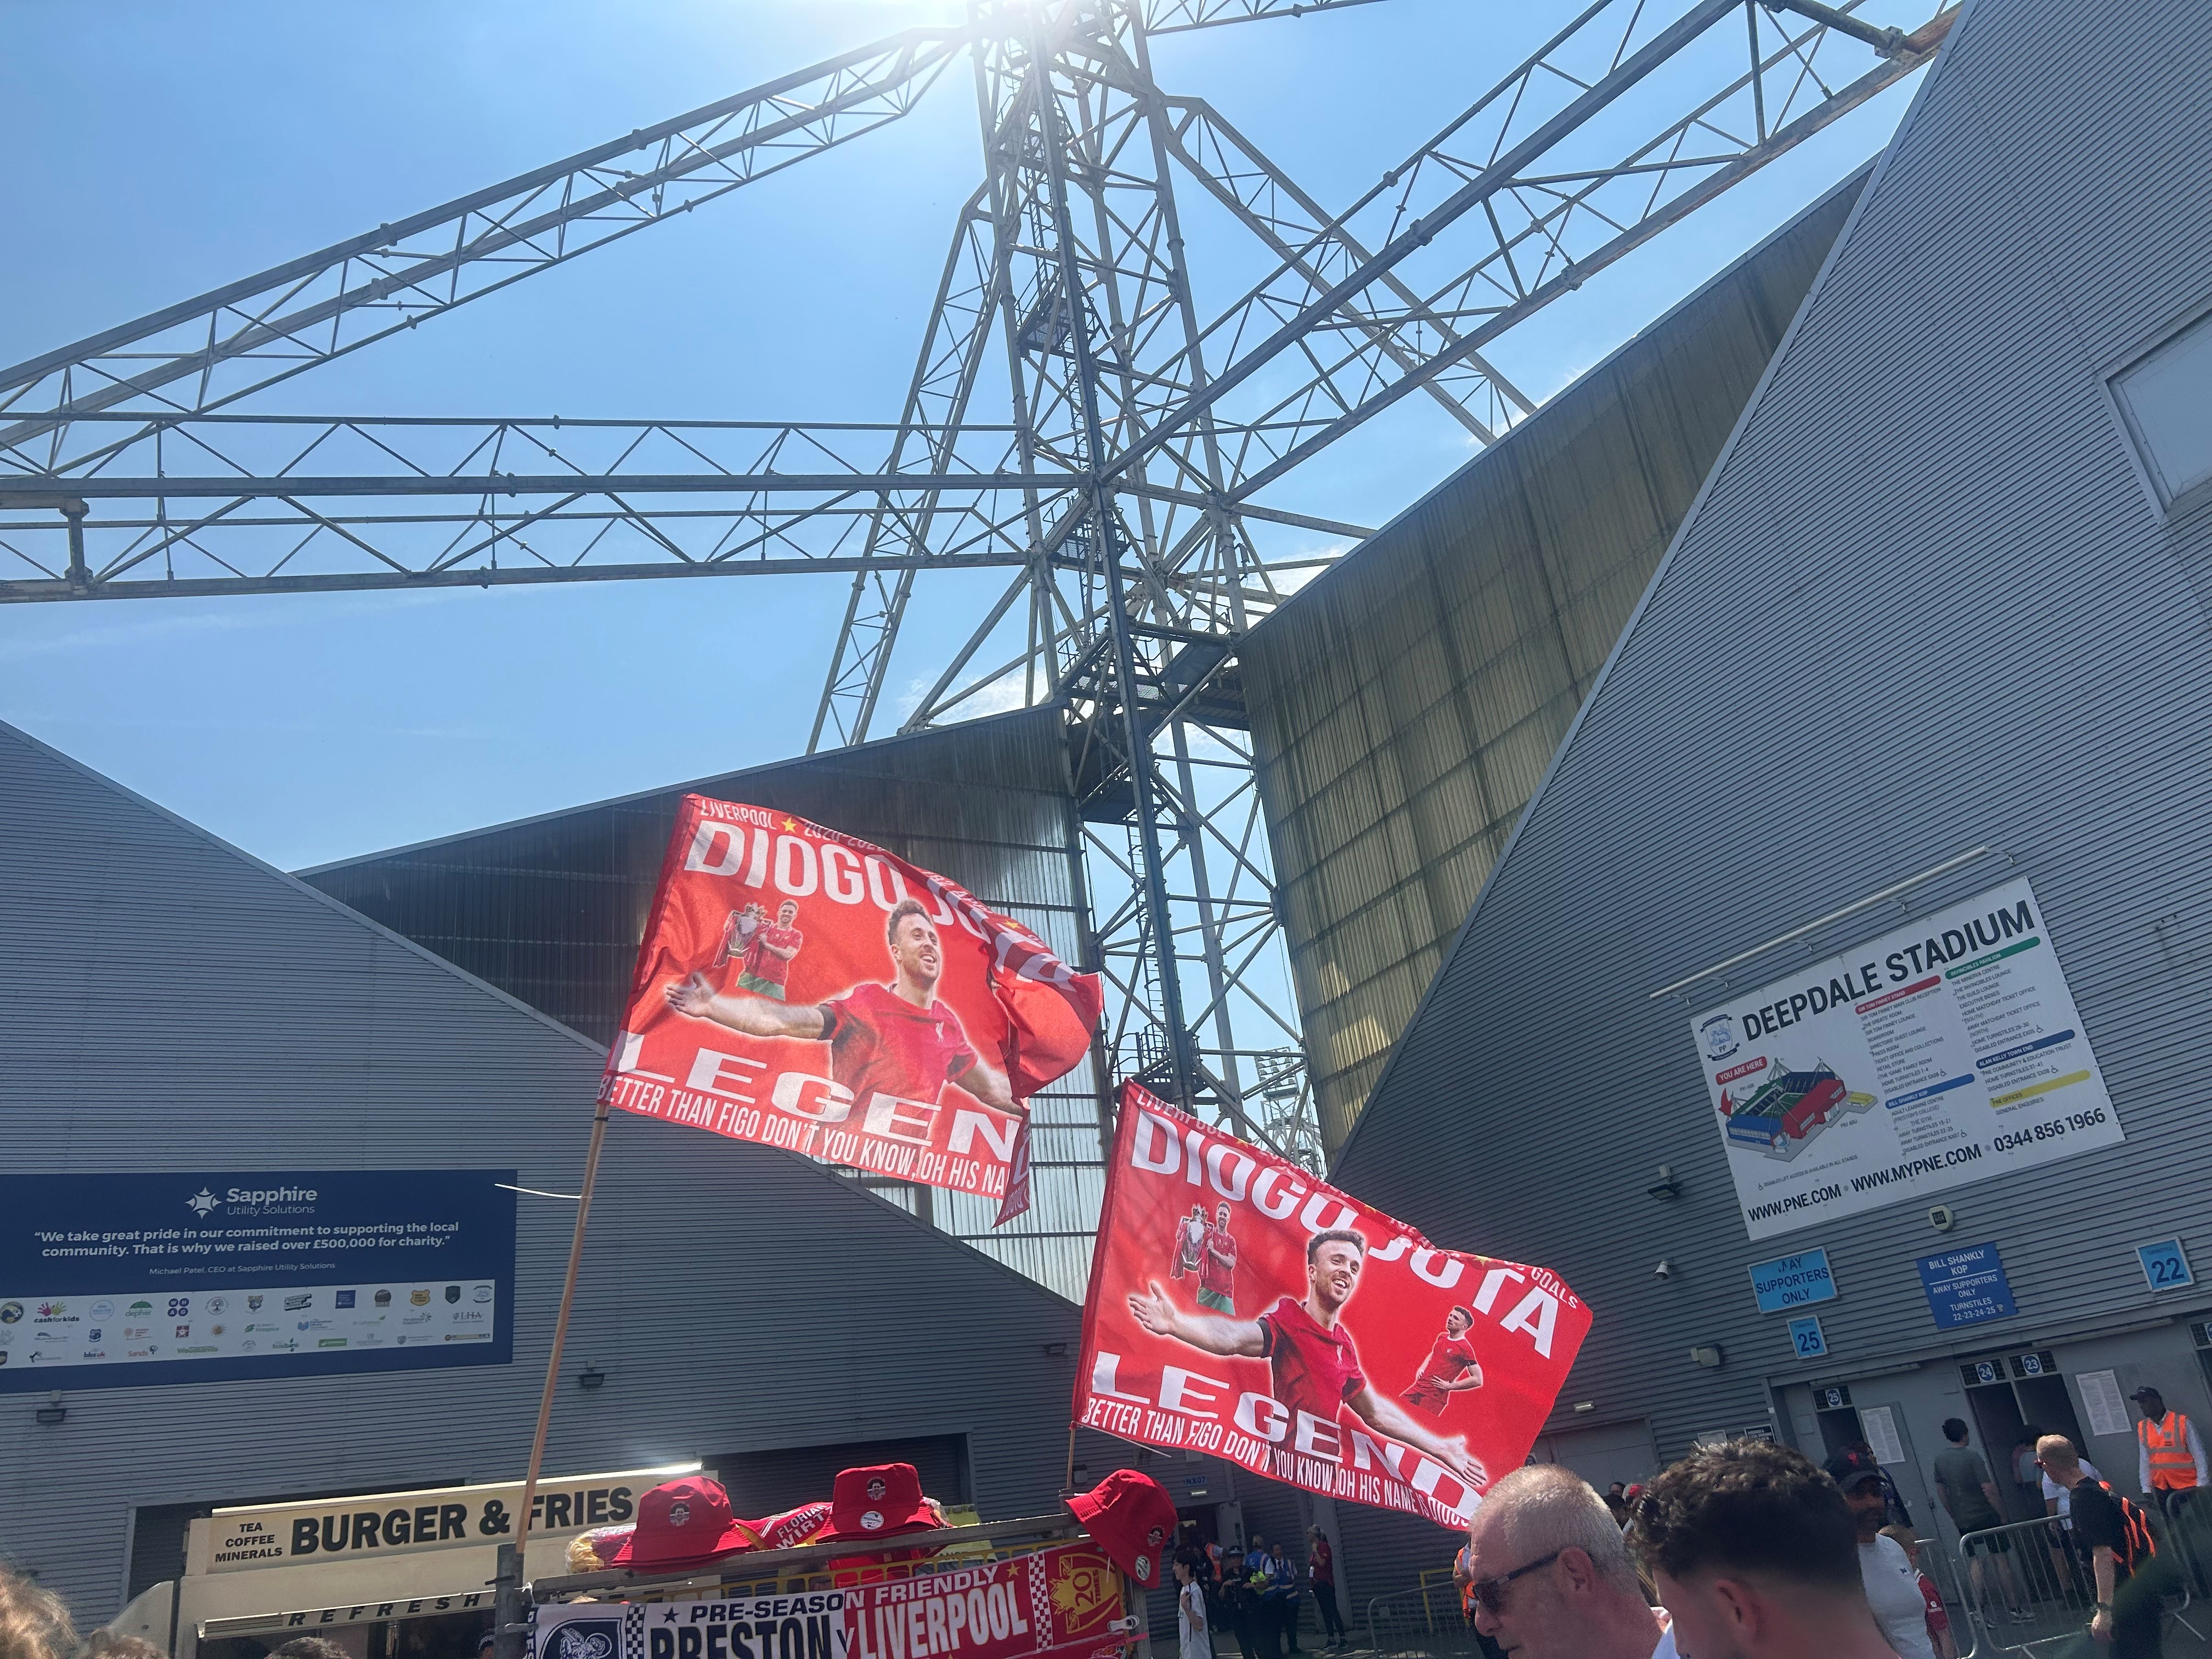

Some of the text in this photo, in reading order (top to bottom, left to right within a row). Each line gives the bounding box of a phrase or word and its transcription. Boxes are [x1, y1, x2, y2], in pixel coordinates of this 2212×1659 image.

[701, 799, 777, 830] LIVERPOOL
[684, 820, 909, 912] DIOGO
[1741, 899, 2036, 1041] DEEPDALE STADIUM
[1875, 996, 1891, 1006] FINNEY
[1891, 990, 1906, 1000] STAND
[1961, 985, 2036, 1017] HOME MATCHDAY TICKET OFFICE
[1966, 1001, 2041, 1031] AWAY MATCHDAY TICKET OFFICE
[1972, 1036, 1986, 1045] HOME
[1986, 1026, 2015, 1040] TURNSTILES
[1979, 1058, 1993, 1066] ALAN
[1992, 1053, 2007, 1062] KELLY
[2007, 1048, 2022, 1057] TOWN
[1992, 1059, 2022, 1073] COMMUNITY
[2026, 1048, 2055, 1062] EDUCATION
[2055, 1042, 2072, 1052] TRUST
[1719, 1058, 1763, 1081] YOU ARE HERE
[1984, 1075, 1999, 1084] HOME
[2000, 1065, 2029, 1079] TURNSTILES
[2002, 1092, 2023, 1102] OFFICES
[599, 1074, 1011, 1196] BETTER THAN FIGO DON'T YOU KNOW, OH HIS NA
[1131, 1108, 1359, 1235] DIOGO
[1747, 1107, 2107, 1222] WWW.PNE.COM WWW.MYPNE.COM 0344 856 1966
[226, 1186, 318, 1205] Sapphire
[227, 1205, 315, 1217] Utility Solutions
[67, 1230, 99, 1242] take
[102, 1231, 140, 1243] great
[143, 1228, 181, 1242] pride
[183, 1228, 198, 1239] in
[200, 1229, 223, 1238] our
[225, 1226, 314, 1238] commitment
[318, 1226, 331, 1235] to
[334, 1223, 404, 1236] supporting
[407, 1222, 427, 1232] the
[430, 1222, 459, 1232] local
[42, 1244, 129, 1257] community.
[132, 1243, 164, 1254] That
[167, 1243, 179, 1254] is
[182, 1243, 212, 1254] why
[215, 1243, 235, 1252] we
[238, 1240, 279, 1251] raised
[281, 1241, 311, 1250] over
[313, 1238, 376, 1249] £500,000
[378, 1237, 396, 1247] for
[149, 1267, 182, 1275] Michael
[237, 1263, 273, 1273] Sapphire
[275, 1263, 298, 1272] Utility
[1929, 1249, 1984, 1269] BILL SHANKLY
[1951, 1265, 1968, 1276] KOP
[2152, 1257, 2185, 1283] 22
[1531, 1267, 1579, 1310] GOALS
[1756, 1267, 1830, 1294] SUPPORTERS
[1933, 1274, 1997, 1294] AWAY SUPPORTERS
[1782, 1288, 1809, 1304] ONLY
[1958, 1288, 1976, 1298] ONLY
[1950, 1297, 1992, 1311] TURNSTILES
[1953, 1306, 1996, 1321] 22-23-24-25
[1798, 1331, 1820, 1352] 25
[1979, 1367, 1992, 1378] 24
[2025, 1359, 2039, 1370] 23
[1827, 1392, 1839, 1403] 25
[1092, 1351, 1483, 1520] LEGEND
[1081, 1397, 1141, 1436] BETTER
[1144, 1410, 1186, 1445] THAN
[1184, 1420, 1223, 1450] FIGO
[1223, 1431, 1271, 1472] DON'T
[1274, 1447, 1294, 1481] YOU
[1297, 1457, 1336, 1497] KNOW,
[1339, 1468, 1355, 1498] OH
[1359, 1473, 1380, 1503] HIS
[1384, 1479, 1418, 1513] NAME
[1185, 1476, 1206, 1485] NX07
[239, 1522, 263, 1533] TEA
[291, 1487, 633, 1556] BURGER & FRIES
[777, 1505, 827, 1538] FLORIAN
[225, 1534, 275, 1548] COFFEE
[215, 1548, 283, 1562] MINERALS
[690, 1565, 999, 1623] PRE-SEASON FRIENDLY
[1073, 1571, 1095, 1607] 20
[287, 1593, 482, 1627] REFRESH
[857, 1581, 1028, 1659] LIVERPOOL
